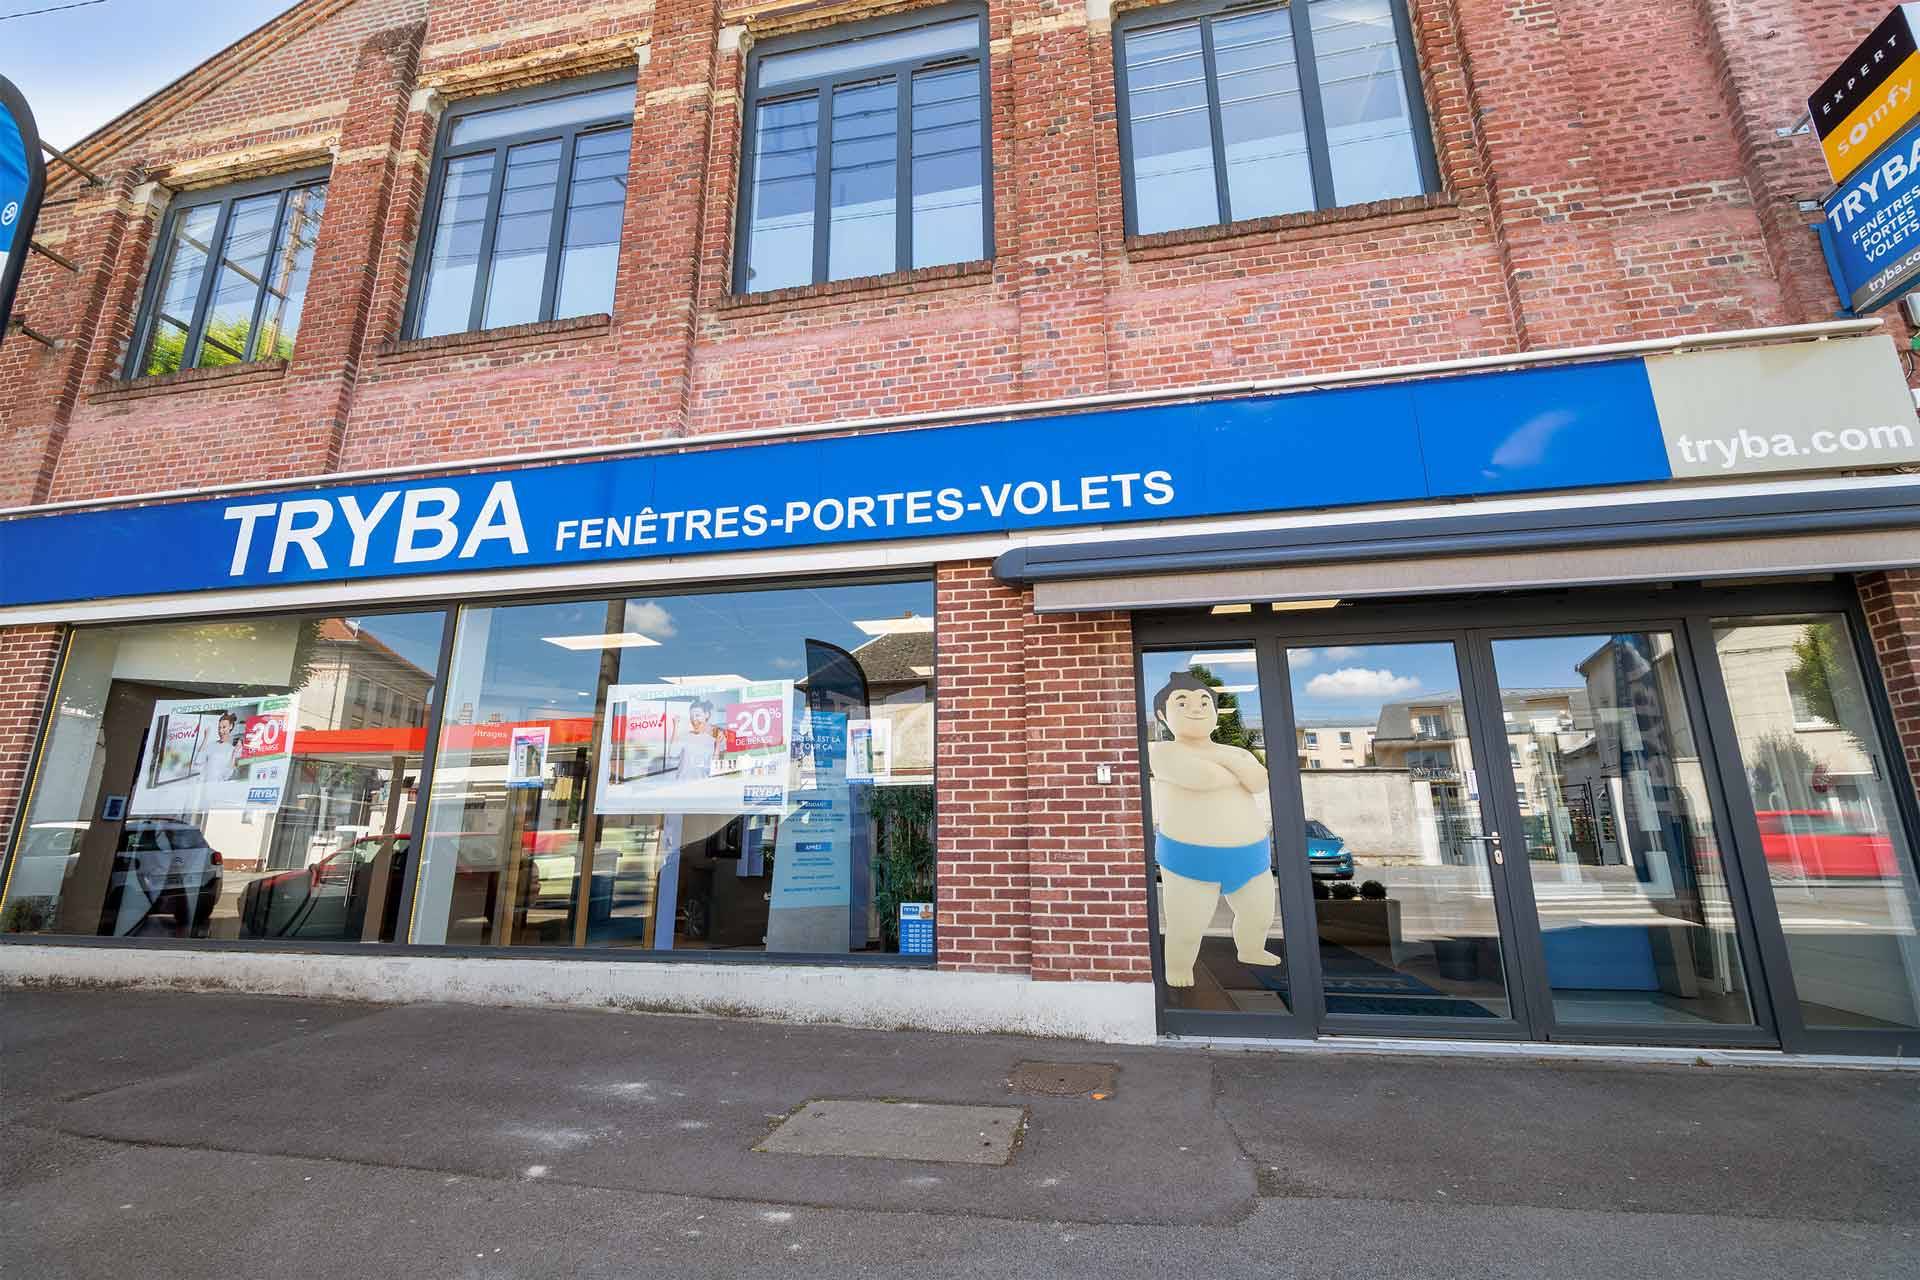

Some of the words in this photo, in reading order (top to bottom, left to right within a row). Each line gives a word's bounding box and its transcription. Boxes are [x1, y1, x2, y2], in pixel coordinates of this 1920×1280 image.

[1822, 34, 1897, 115] EXPERT
[1836, 79, 1912, 158] somfy
[1852, 184, 1920, 245] FENÊTRES
[1862, 206, 1916, 252] PORTES
[1865, 218, 1920, 263] VOLETS
[1677, 423, 1914, 469] tryba.com
[223, 480, 529, 577] TRYBA
[728, 707, 782, 738] -20%
